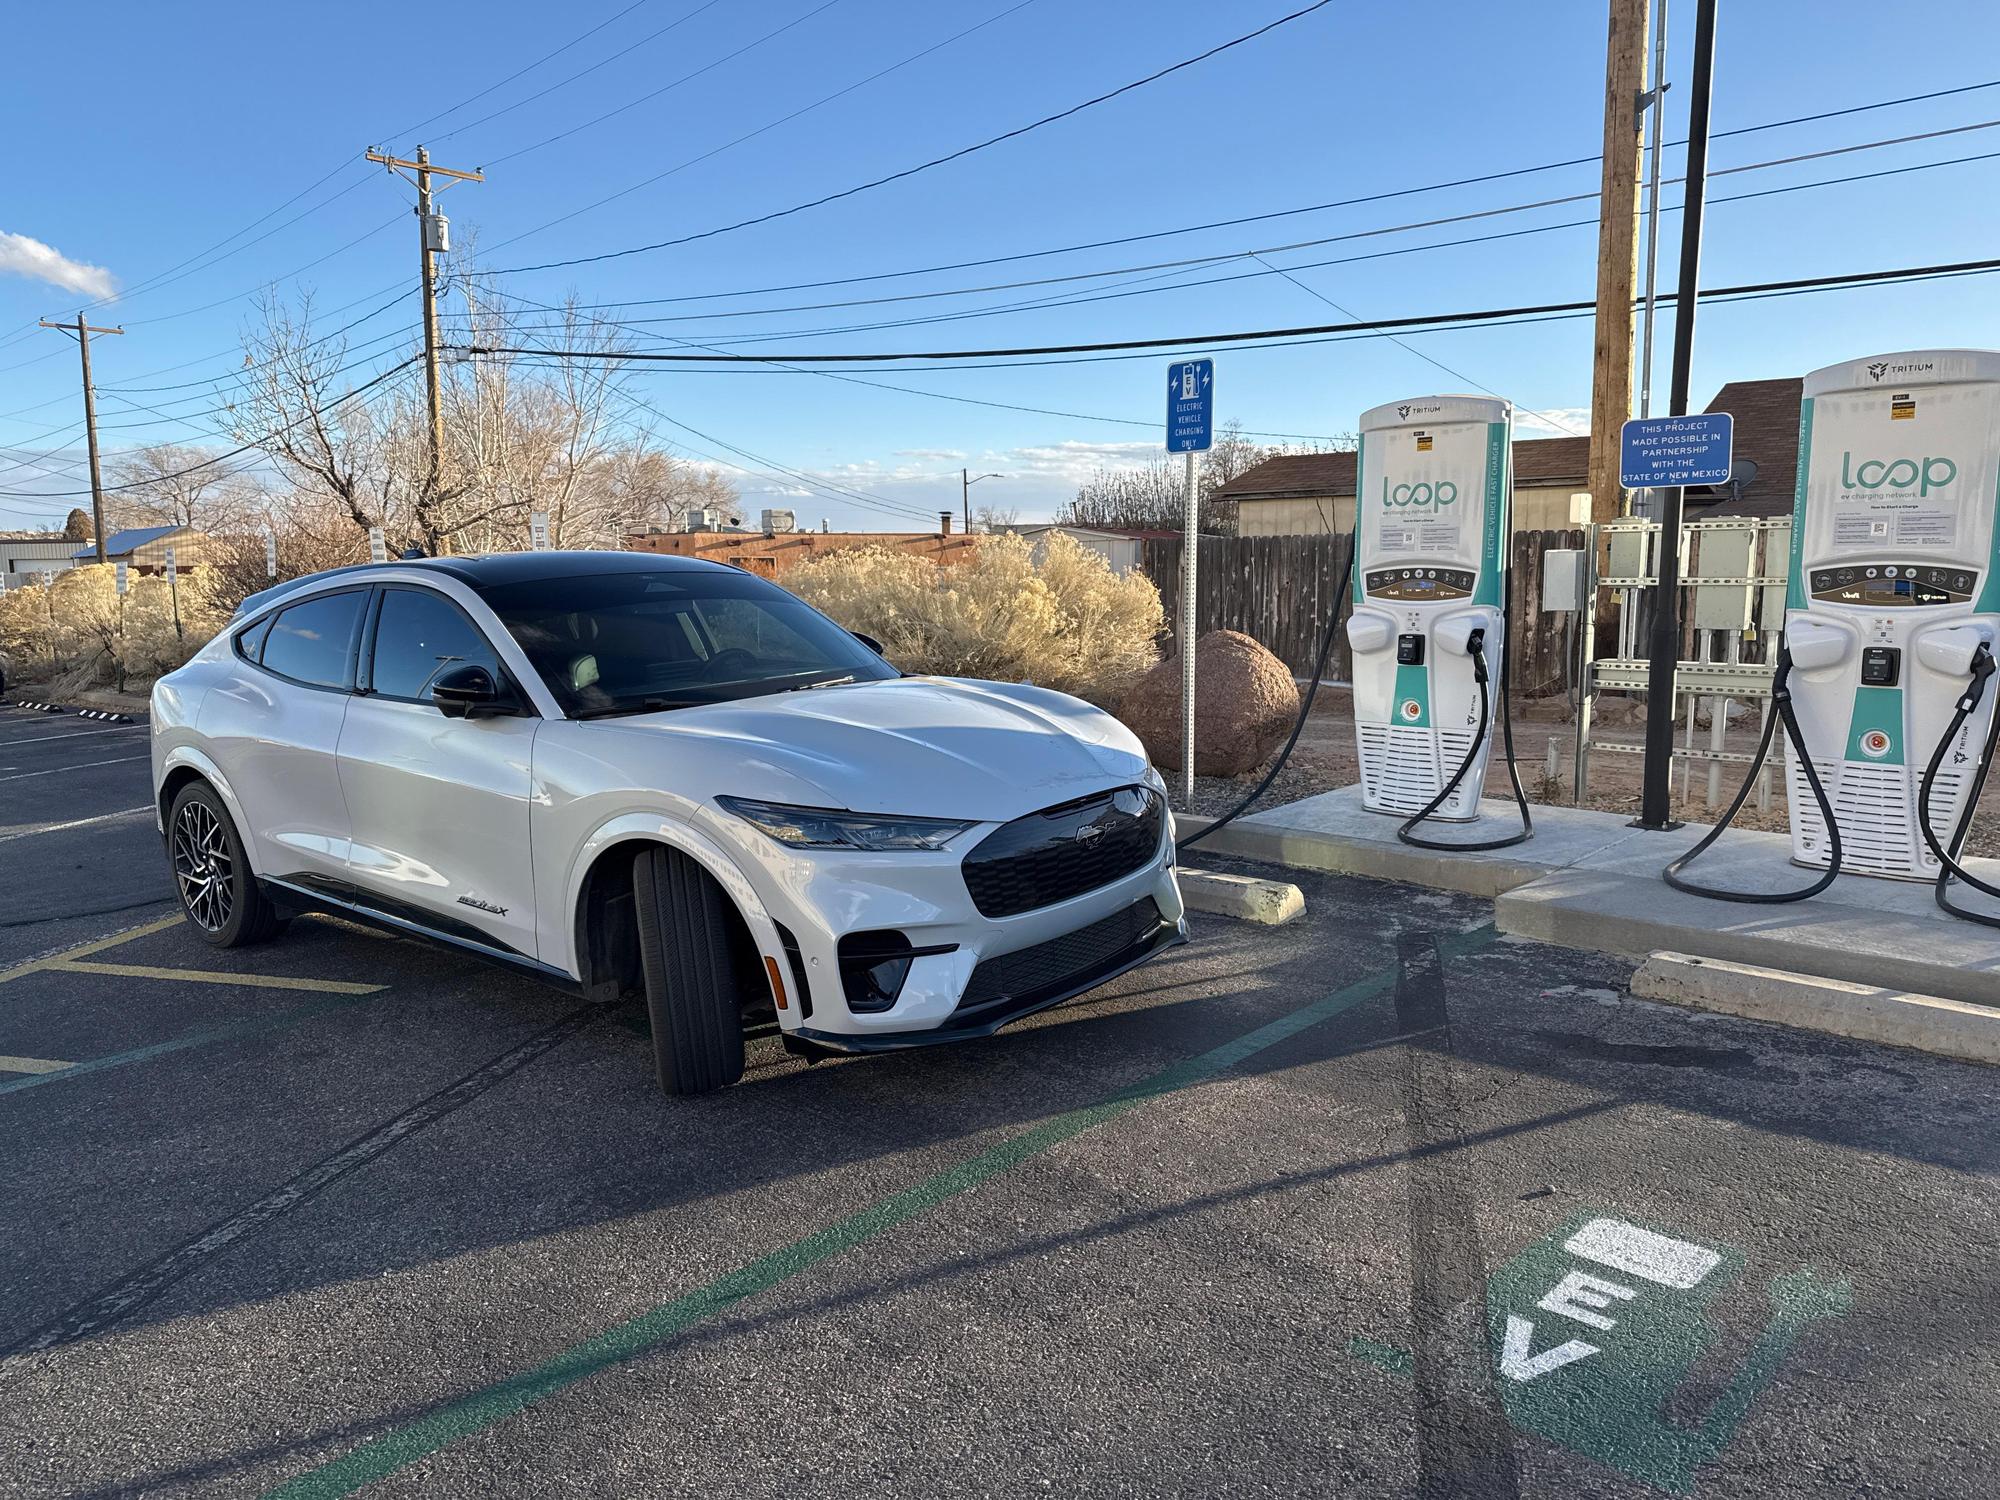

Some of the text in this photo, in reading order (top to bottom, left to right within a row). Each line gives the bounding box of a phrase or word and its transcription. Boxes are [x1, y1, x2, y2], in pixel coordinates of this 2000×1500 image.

[1892, 363, 1933, 373] TRITIUM
[1186, 376, 1191, 396] EV
[1176, 402, 1203, 413] ELECTRIC
[1413, 406, 1441, 414] TRITIUM
[1178, 415, 1201, 424] VEHICLE
[1175, 426, 1204, 437] CHARGING
[1642, 422, 1708, 434] THIS PROJECT
[1182, 439, 1197, 448] ONLY
[1632, 433, 1721, 446] MADE POSSIBLE IN
[1642, 446, 1709, 457] PARTNERSHIP
[1492, 441, 1500, 475] CHARGER
[1678, 459, 1695, 467] THE
[1623, 473, 1651, 482] STATE
[1669, 471, 1689, 479] NEW
[1692, 469, 1728, 478] MEXICO
[1842, 452, 1957, 497] loop
[1383, 477, 1458, 513] loop
[1852, 493, 1884, 501] charging
[1489, 495, 1497, 525] VEHICLE
[1487, 526, 1495, 558] ELECTRIC
[1960, 726, 1969, 750] TRITIUM
[1501, 1270, 1638, 1381] EV
